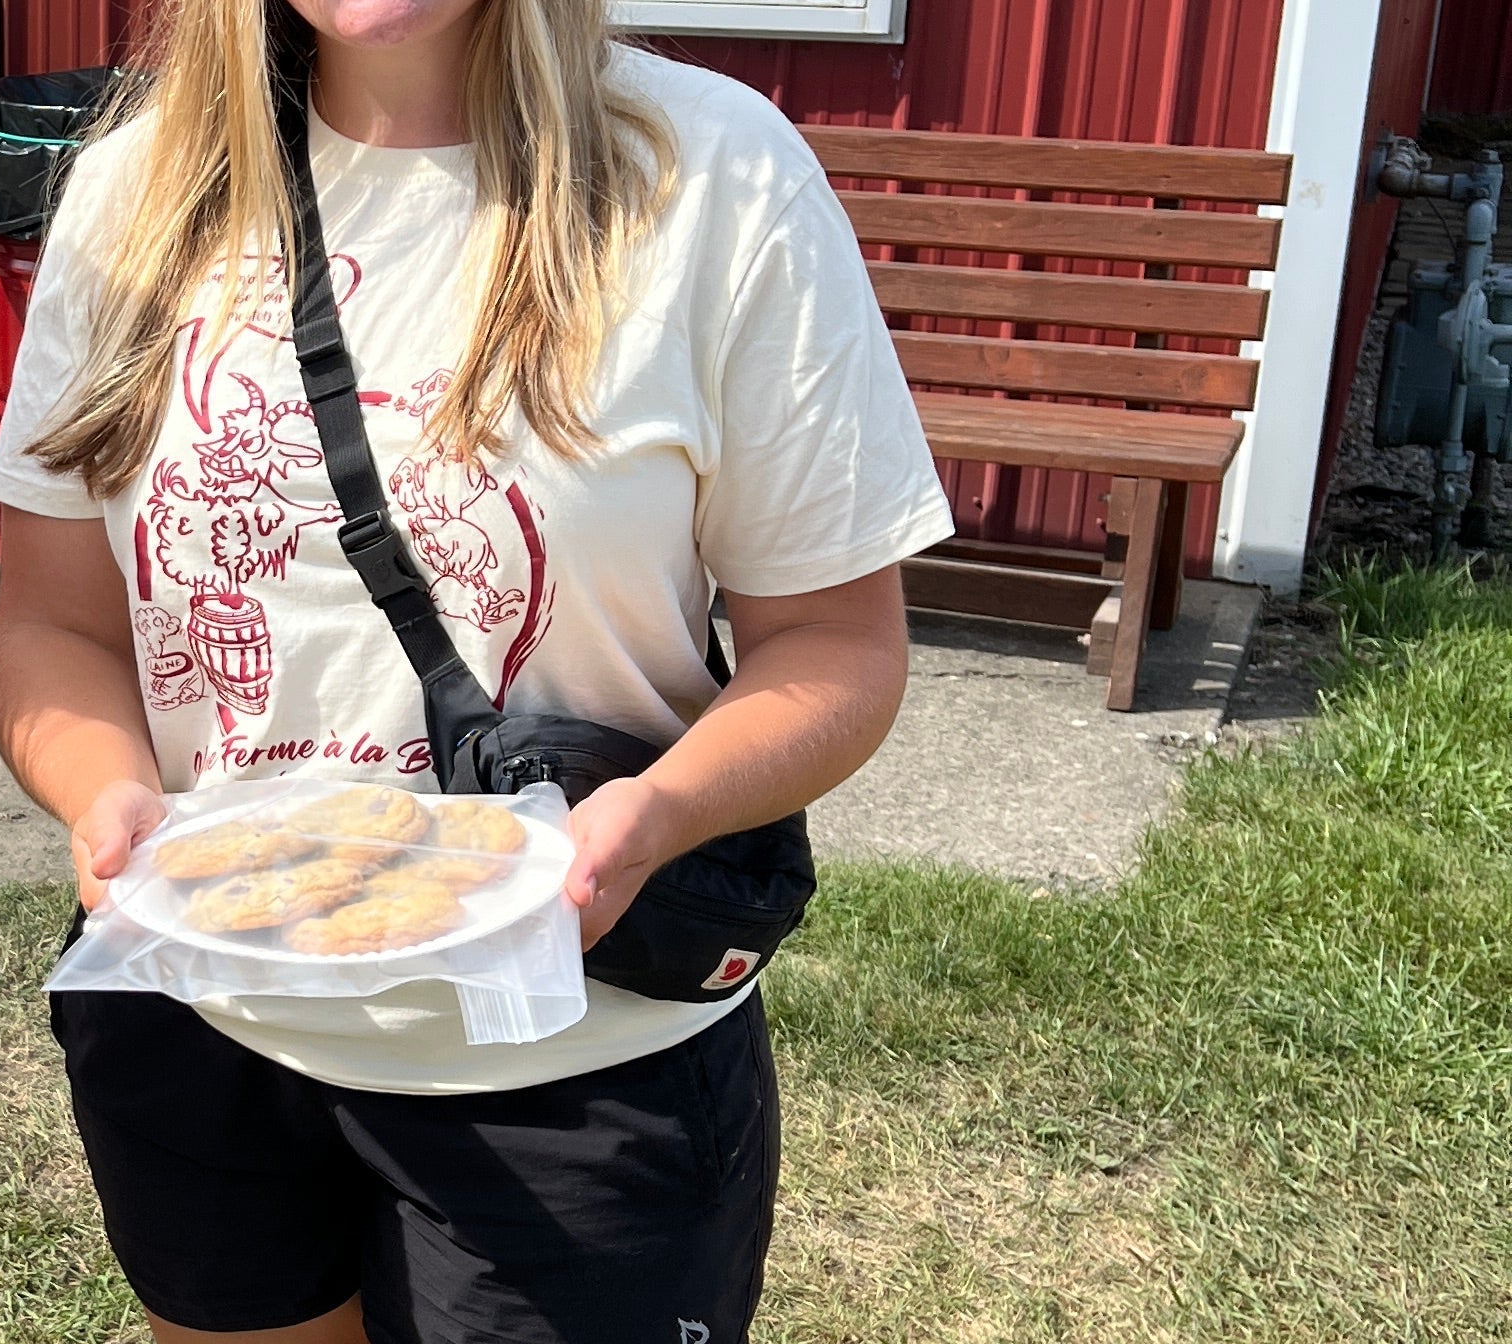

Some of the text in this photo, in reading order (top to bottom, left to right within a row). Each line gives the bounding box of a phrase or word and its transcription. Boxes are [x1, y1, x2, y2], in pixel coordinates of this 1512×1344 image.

[220, 734, 319, 773] Ferme
[323, 729, 348, 758] à
[350, 732, 390, 765] la
